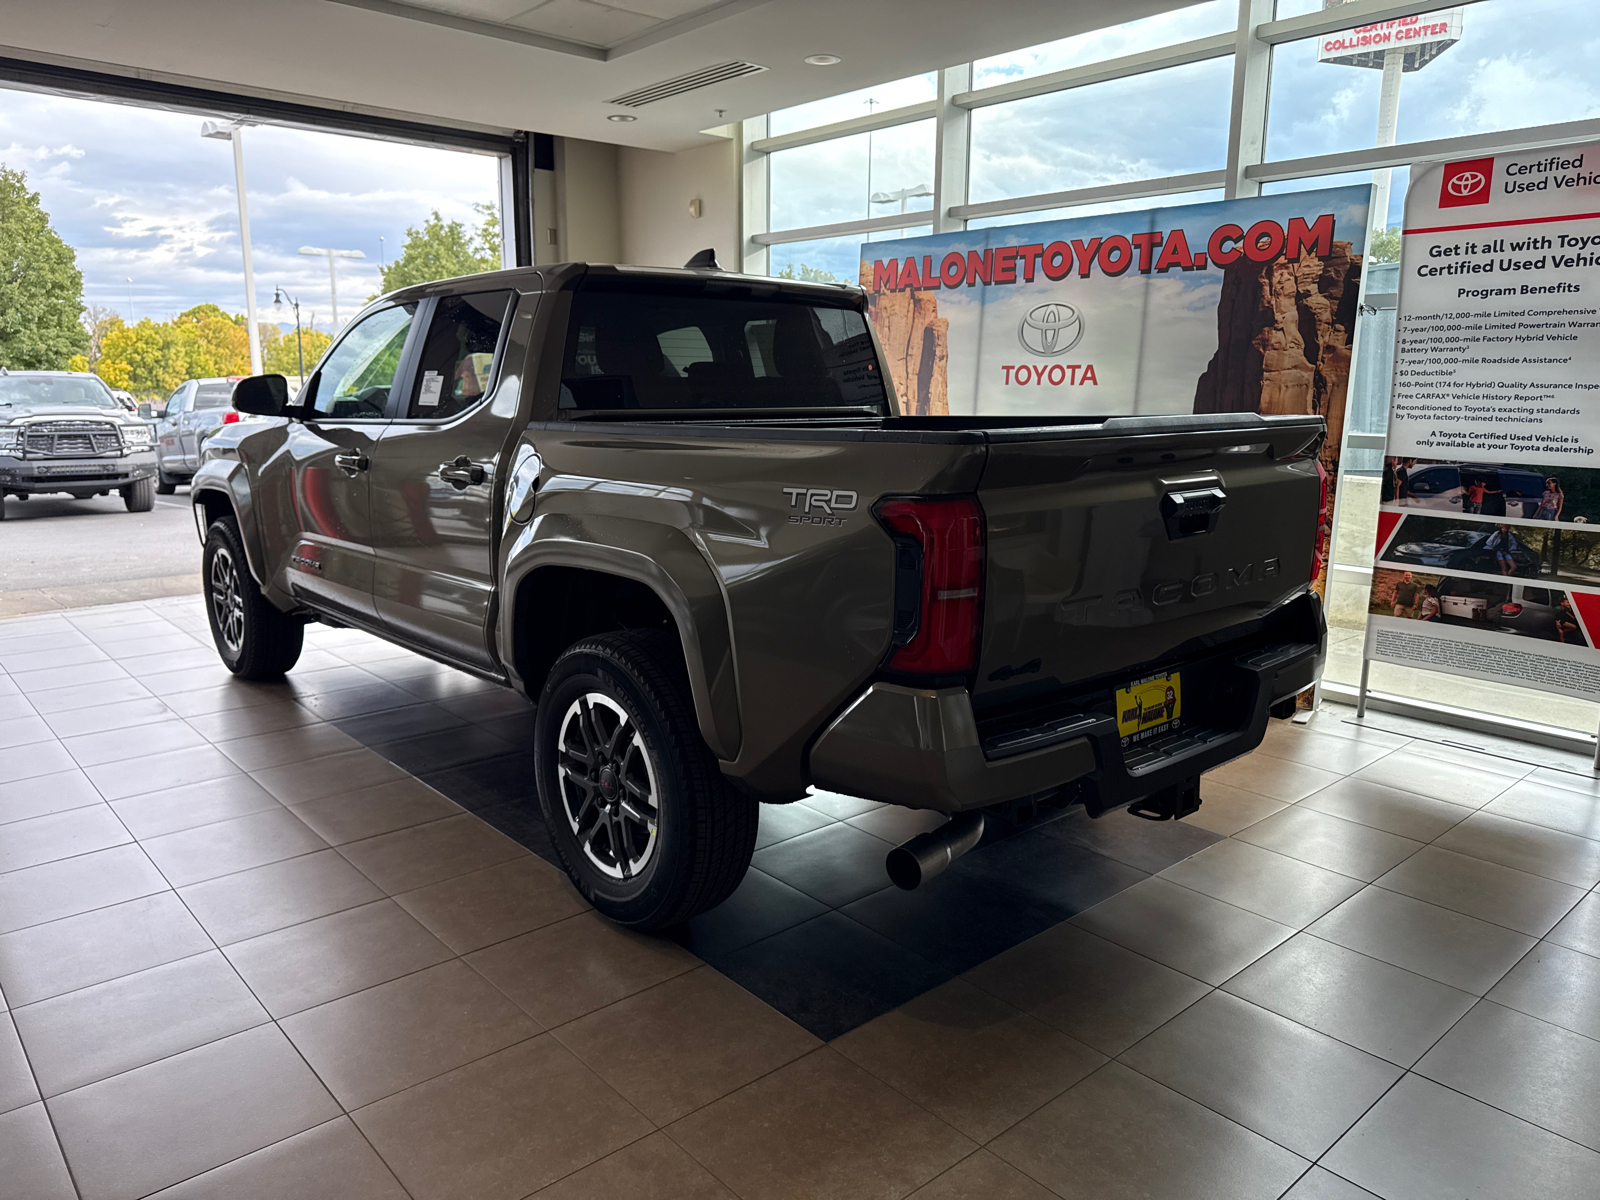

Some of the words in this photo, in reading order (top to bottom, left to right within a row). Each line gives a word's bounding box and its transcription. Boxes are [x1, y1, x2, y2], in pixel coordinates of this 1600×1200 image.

[1324, 32, 1391, 52] COLLISION
[1395, 22, 1448, 41] CENTER
[1506, 154, 1584, 176] Certified
[1505, 177, 1548, 194] Used
[872, 213, 1335, 293] MALONETOYOTA.COM
[1429, 245, 1460, 258] Get
[1465, 242, 1476, 255] it
[1482, 239, 1504, 254] all
[1510, 236, 1552, 252] with
[1558, 235, 1600, 250] Toyo
[1417, 259, 1494, 277] Certified
[1499, 256, 1546, 271] Used
[1458, 286, 1516, 300] Program
[1520, 282, 1580, 295] Benefits
[1404, 311, 1491, 322] 12-month/12,000-mile
[1493, 310, 1525, 318] Limited
[1527, 308, 1597, 317] Comprehensive
[1403, 324, 1483, 334] 7-year/100,000-mile
[1518, 321, 1565, 329] Powertrain
[1401, 336, 1480, 345] 8-year/100,000-mile
[1483, 335, 1513, 343] Factory
[1515, 334, 1543, 342] Hybrid
[1400, 357, 1479, 365] 7-year/100,000-mile
[1001, 364, 1098, 387] TOYOTA
[1435, 381, 1451, 389] (174
[1466, 381, 1495, 389] Hybrid)
[1497, 381, 1527, 390] Quality
[1482, 394, 1512, 402] History
[1397, 404, 1452, 412] Reconditioned
[1464, 405, 1496, 414] Toyota's
[1498, 407, 1534, 415] exacting
[1536, 407, 1580, 415] standards
[1396, 413, 1405, 421] by
[1407, 413, 1431, 421] Toyota
[1433, 414, 1493, 423] factory-trained
[1495, 415, 1543, 423] technicians
[1438, 431, 1466, 440] Toyota
[1469, 432, 1507, 441] Certified
[1509, 433, 1533, 441] Used
[1535, 435, 1569, 443] Vehicle
[1571, 436, 1579, 444] is
[1416, 439, 1434, 447] only
[1487, 443, 1508, 451] your
[1510, 443, 1541, 452] Toyota
[1542, 444, 1594, 455] dealership
[782, 487, 859, 516] TRD
[788, 516, 848, 527] SPORT
[1060, 557, 1281, 622] TACOMA
[1166, 690, 1174, 700] 32
[1132, 733, 1140, 742] WE
[1140, 729, 1152, 740] MAKE
[1152, 726, 1158, 735] IT
[1158, 724, 1169, 733] EASY
